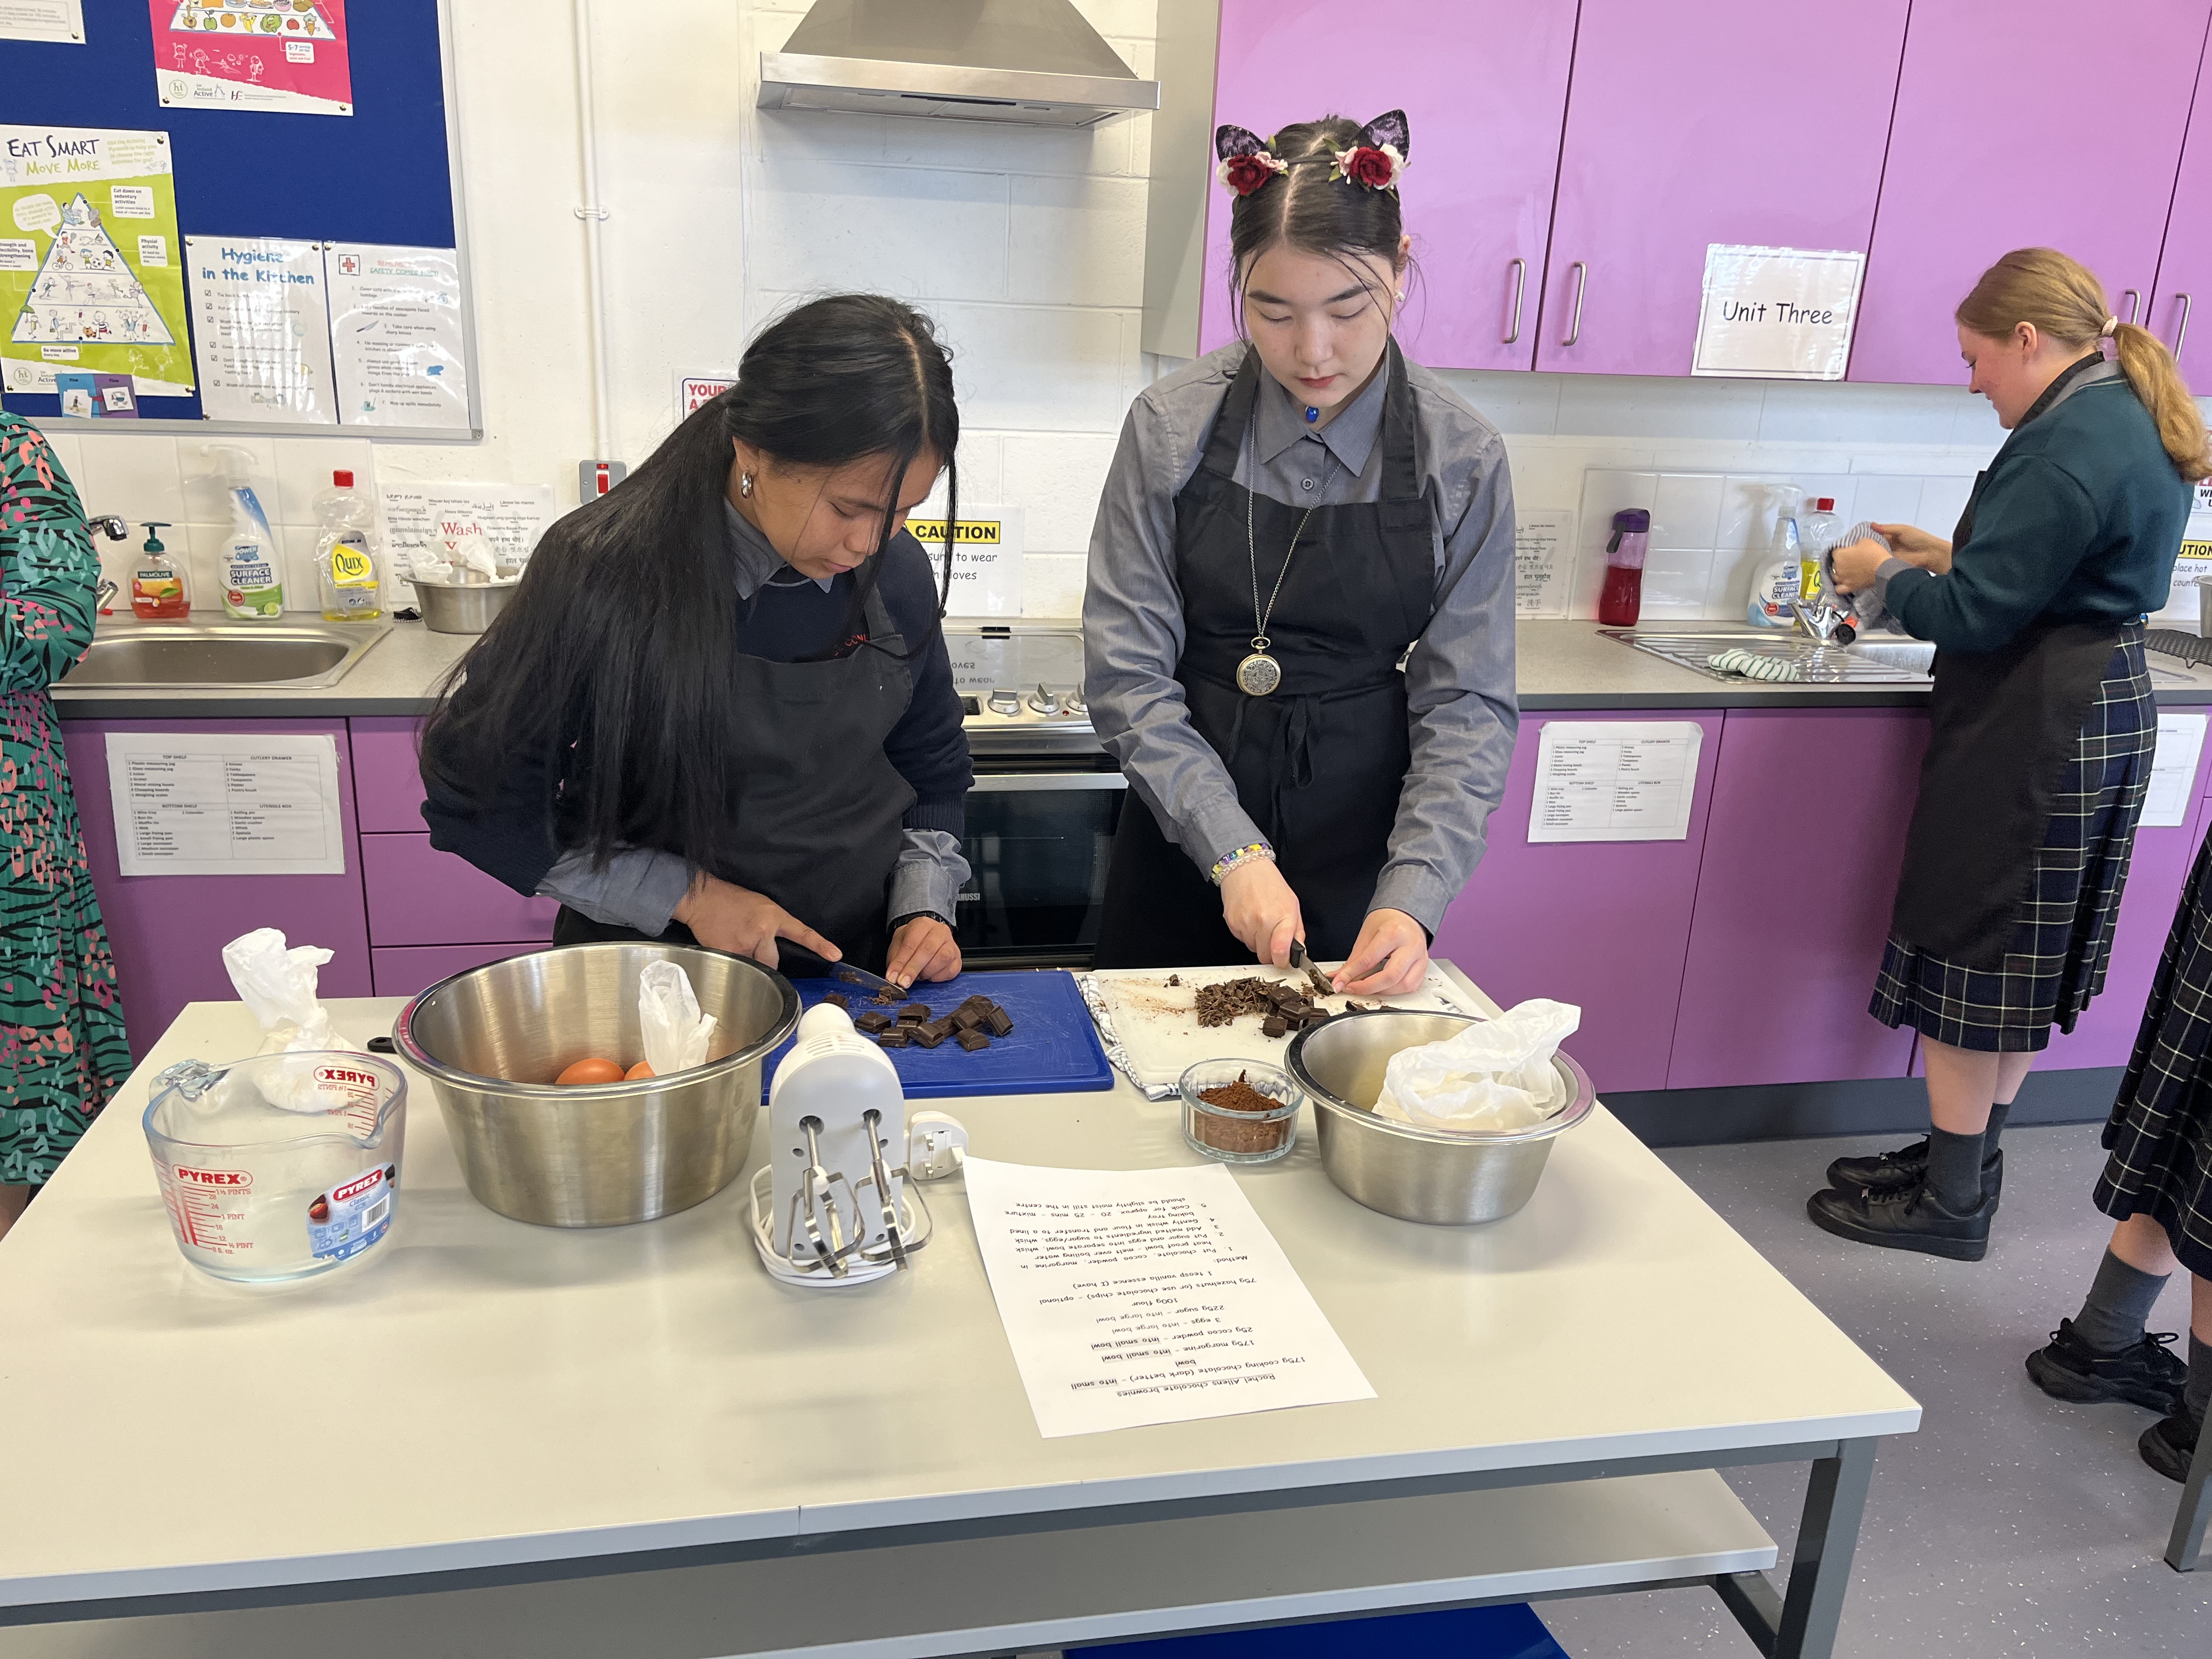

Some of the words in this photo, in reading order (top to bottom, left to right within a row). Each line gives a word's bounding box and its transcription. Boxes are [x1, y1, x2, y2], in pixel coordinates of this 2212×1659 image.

[7, 138, 42, 158] EAT
[46, 135, 100, 158] SMART
[26, 160, 62, 176] MOVE
[67, 158, 100, 172] MORE
[222, 247, 284, 265] Hygiene
[202, 267, 216, 280] in
[222, 268, 249, 281] the
[256, 269, 314, 285] Kitchen
[1723, 301, 1767, 322] Unit
[1776, 302, 1833, 324] Three
[441, 522, 483, 536] Wash
[928, 552, 946, 561] sur
[956, 552, 967, 562] to
[971, 554, 997, 562] wear
[230, 568, 270, 578] SURFACE
[2194, 563, 2207, 573] hot
[231, 576, 272, 585] CLEANER
[958, 893, 980, 901] NUSSI
[337, 1172, 379, 1199] PYREX
[349, 1193, 370, 1207] Classic
[1107, 1230, 1152, 1238] ingredients
[1040, 1296, 1074, 1305] optional
[1172, 1330, 1204, 1339] powder
[1183, 1342, 1228, 1351] margarine
[1130, 1373, 1165, 1382] better)
[1169, 1369, 1194, 1378] (dark
[1245, 1374, 1276, 1383] Rachel
[1071, 1381, 1094, 1390] small
[1164, 1382, 1207, 1392] chocolate
[1212, 1379, 1239, 1387] Allens
[1117, 1387, 1159, 1397] brownies
